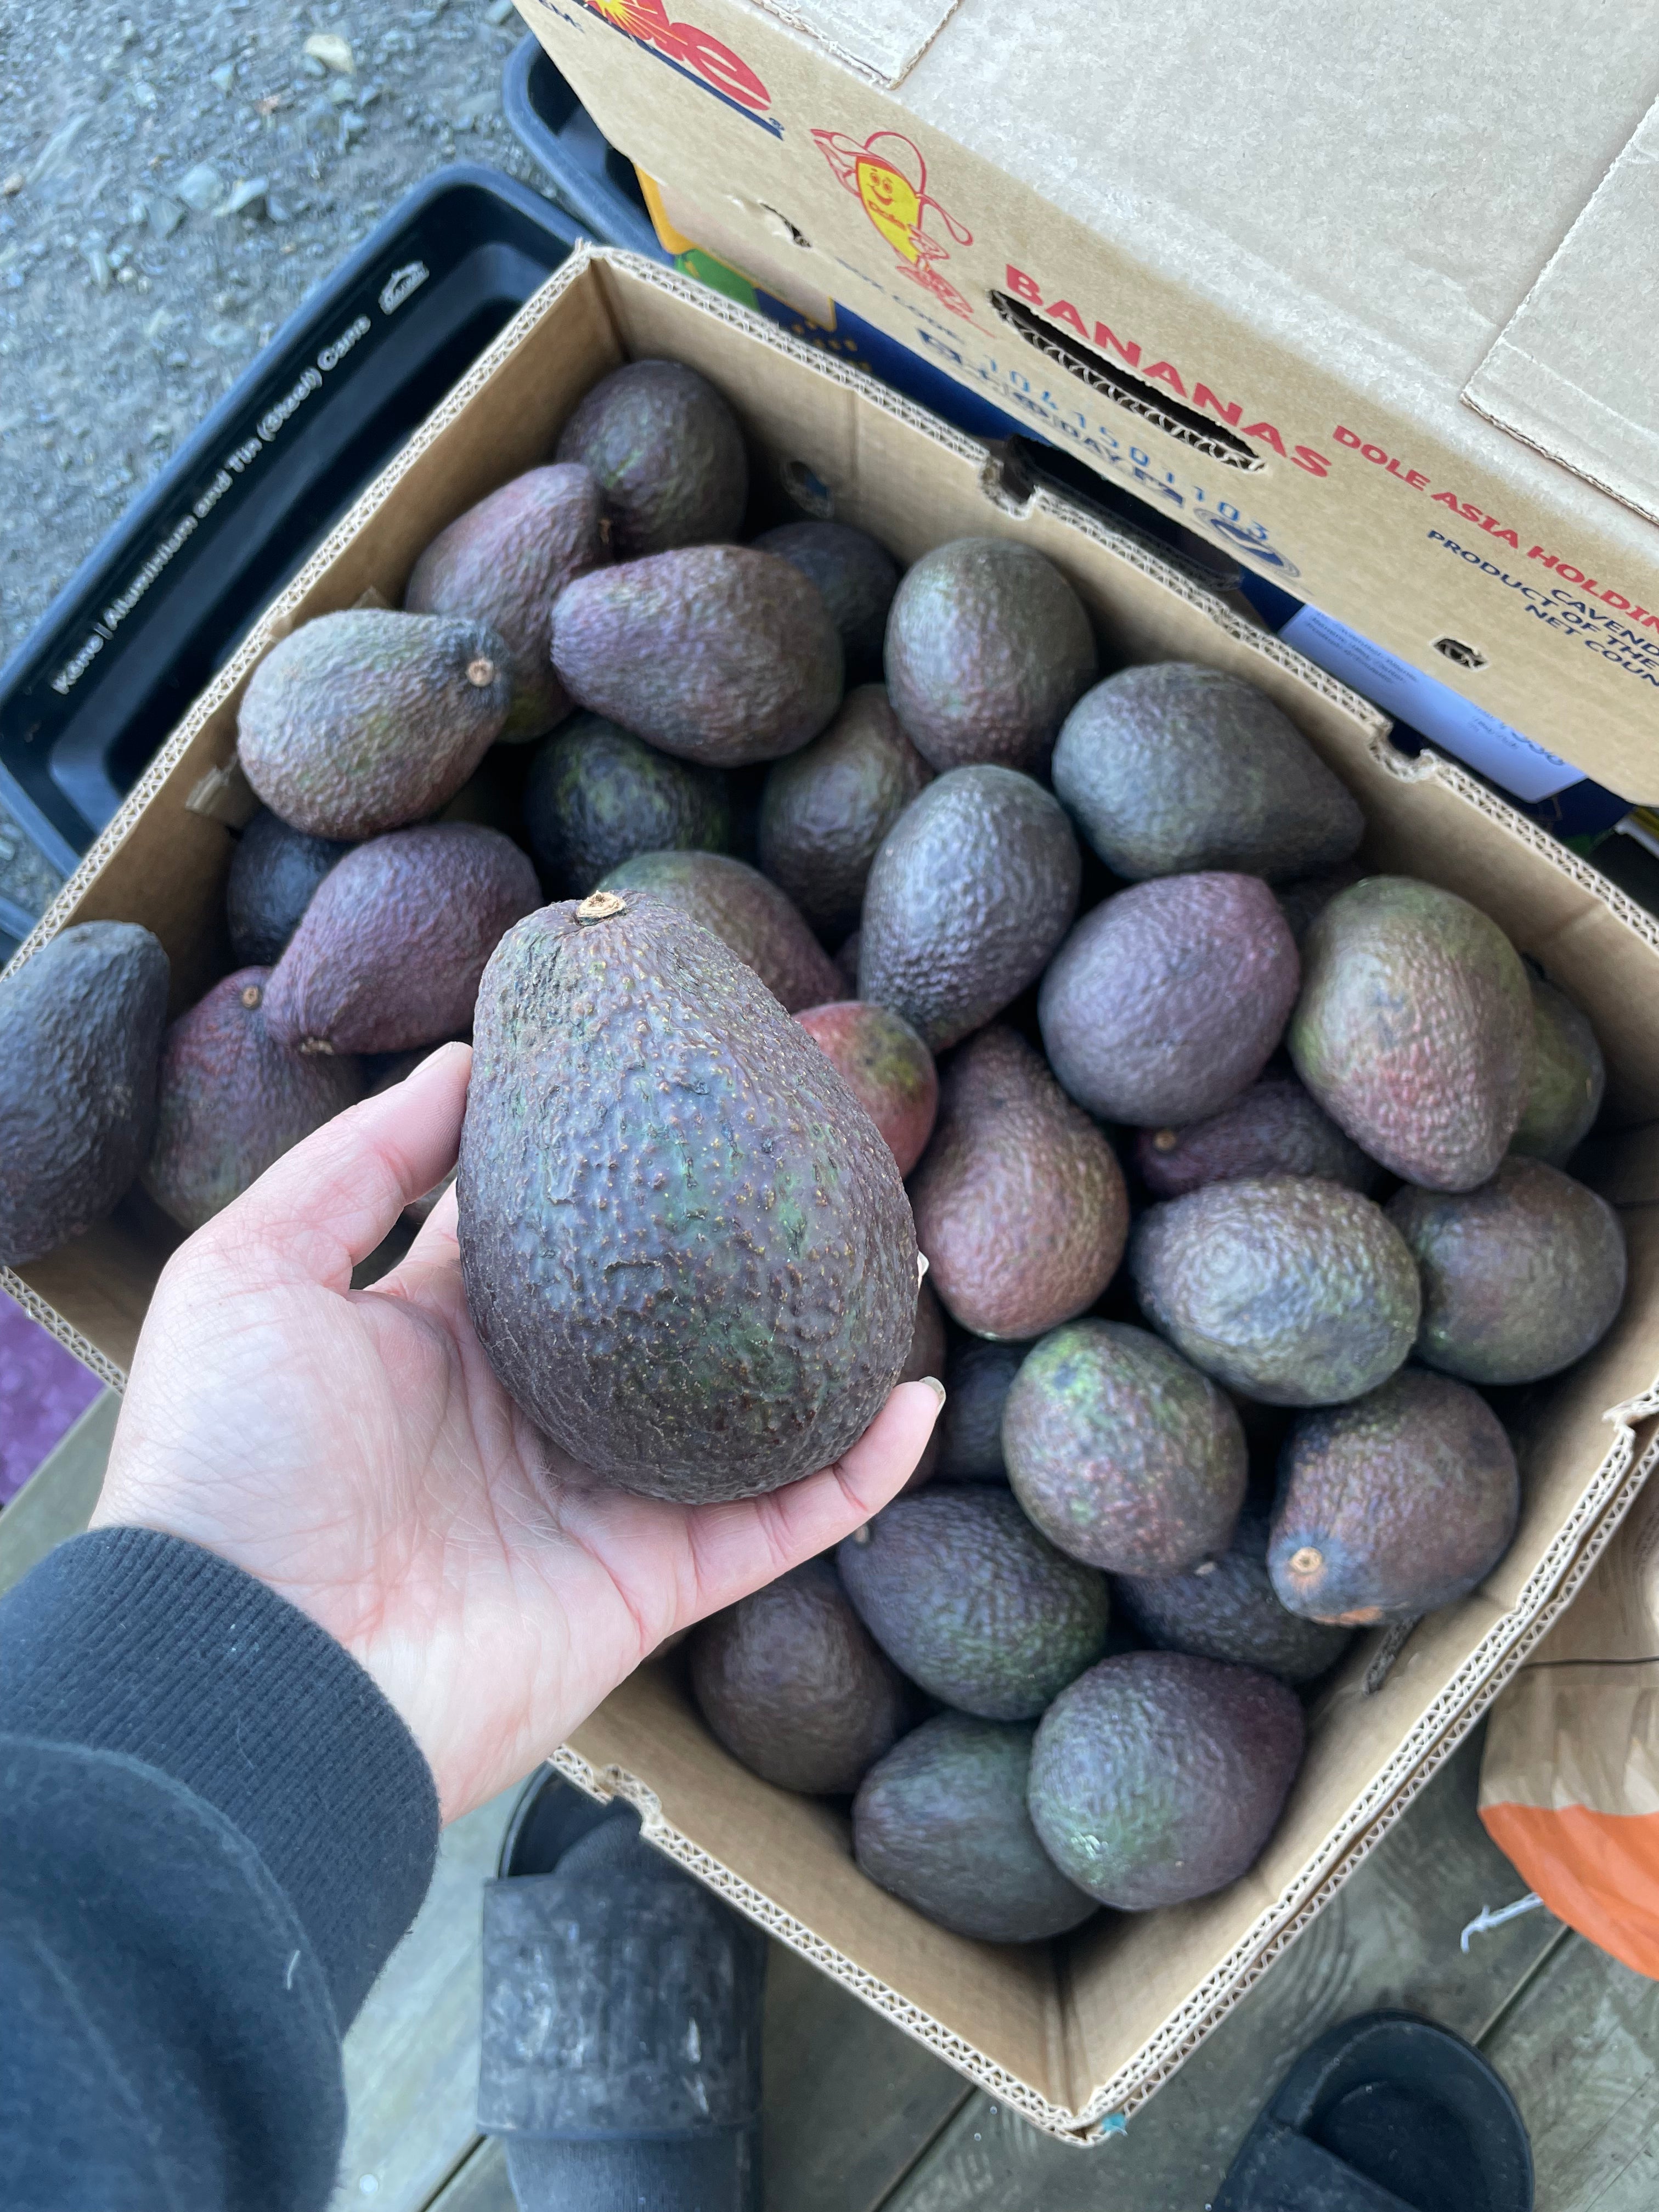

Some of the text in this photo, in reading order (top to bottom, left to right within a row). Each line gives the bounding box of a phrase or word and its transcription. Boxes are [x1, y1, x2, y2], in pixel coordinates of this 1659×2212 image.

[1005, 264, 1332, 477] BANANAS
[103, 515, 198, 630] Aluminium
[194, 469, 233, 518] and
[224, 437, 262, 473] Tin
[257, 366, 323, 442] (Steel)
[317, 314, 371, 371] Cans
[1333, 425, 1431, 492] DOLE
[1430, 492, 1519, 549] ASIA
[1427, 529, 1659, 670] PRODUCT OF THE
[1525, 604, 1582, 635] NET
